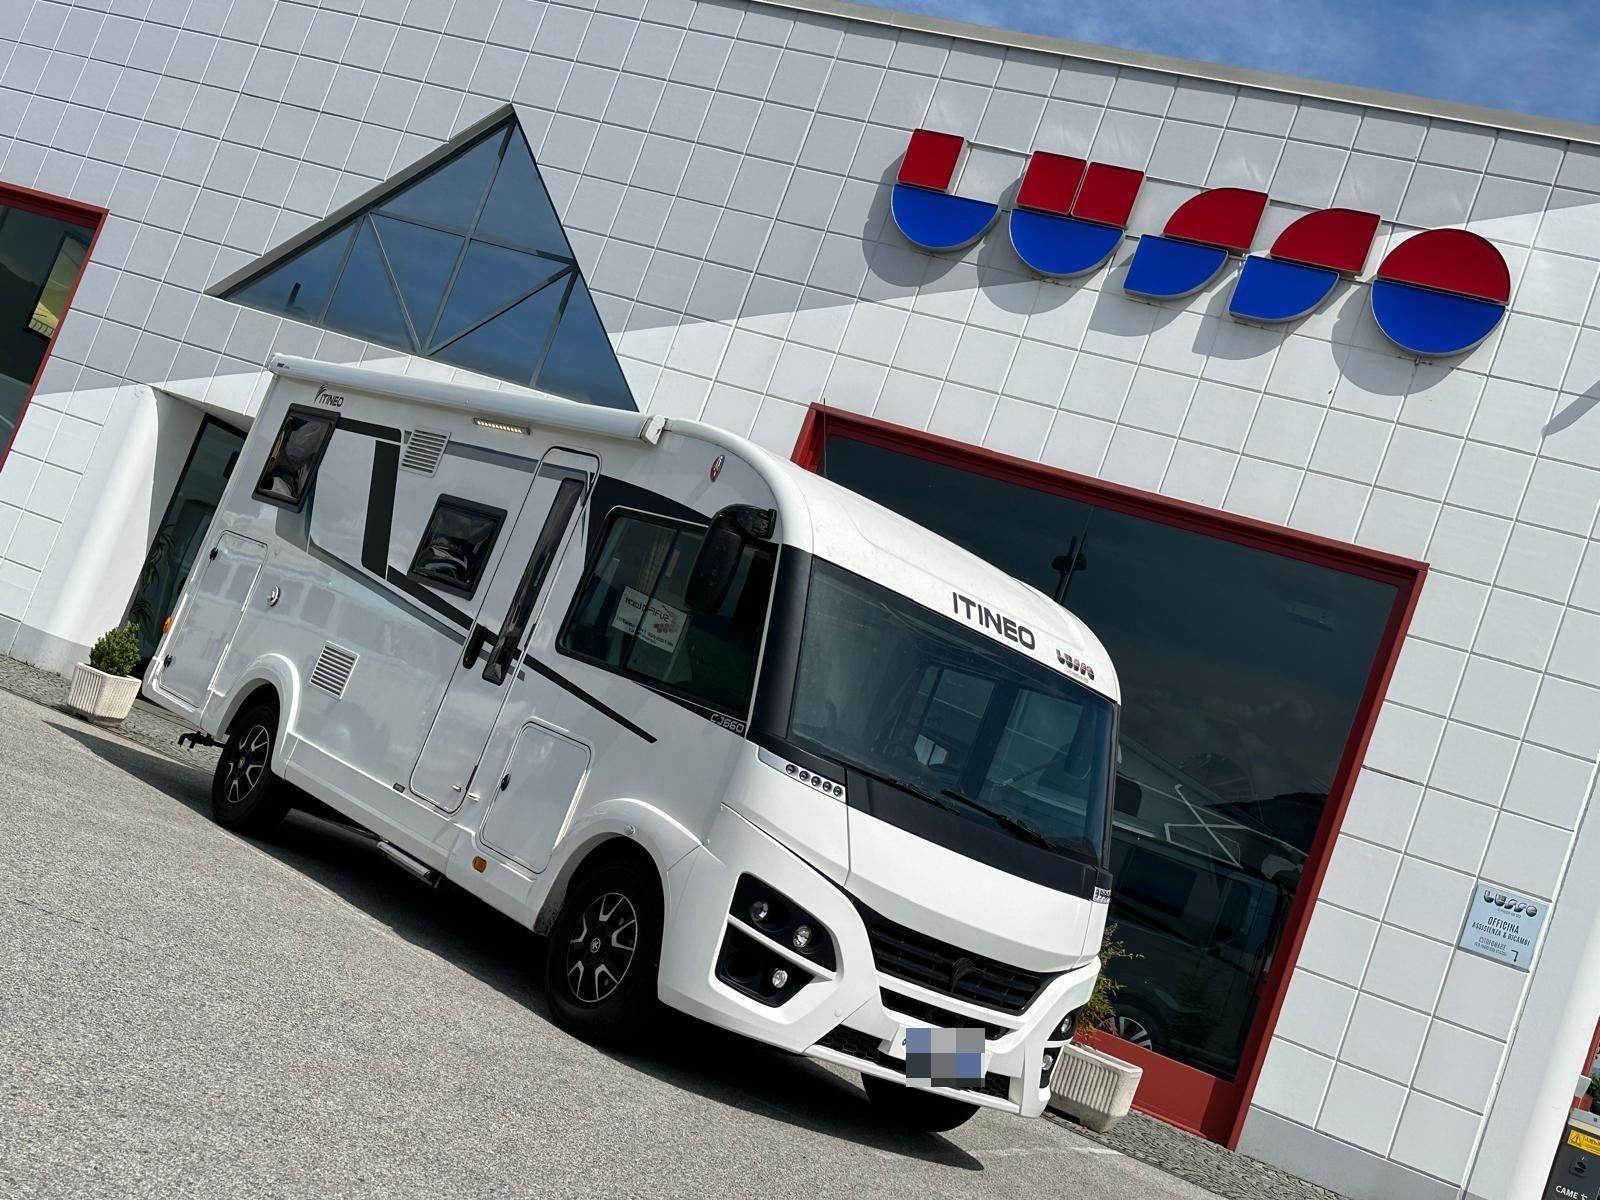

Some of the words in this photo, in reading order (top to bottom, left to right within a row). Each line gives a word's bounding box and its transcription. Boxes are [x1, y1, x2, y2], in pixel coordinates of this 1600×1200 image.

[891, 128, 1511, 357] LUSSO
[318, 392, 344, 407] ITINEO
[952, 591, 1036, 650] ITINEO
[710, 713, 745, 733] CJ660
[1483, 889, 1538, 918] LUSSO
[1471, 921, 1502, 937] ASSISTENZA
[1502, 931, 1507, 939] &
[1508, 933, 1531, 946] RICAMBI
[1487, 916, 1520, 934] OFFICINA
[1555, 1185, 1579, 1200] CAME
